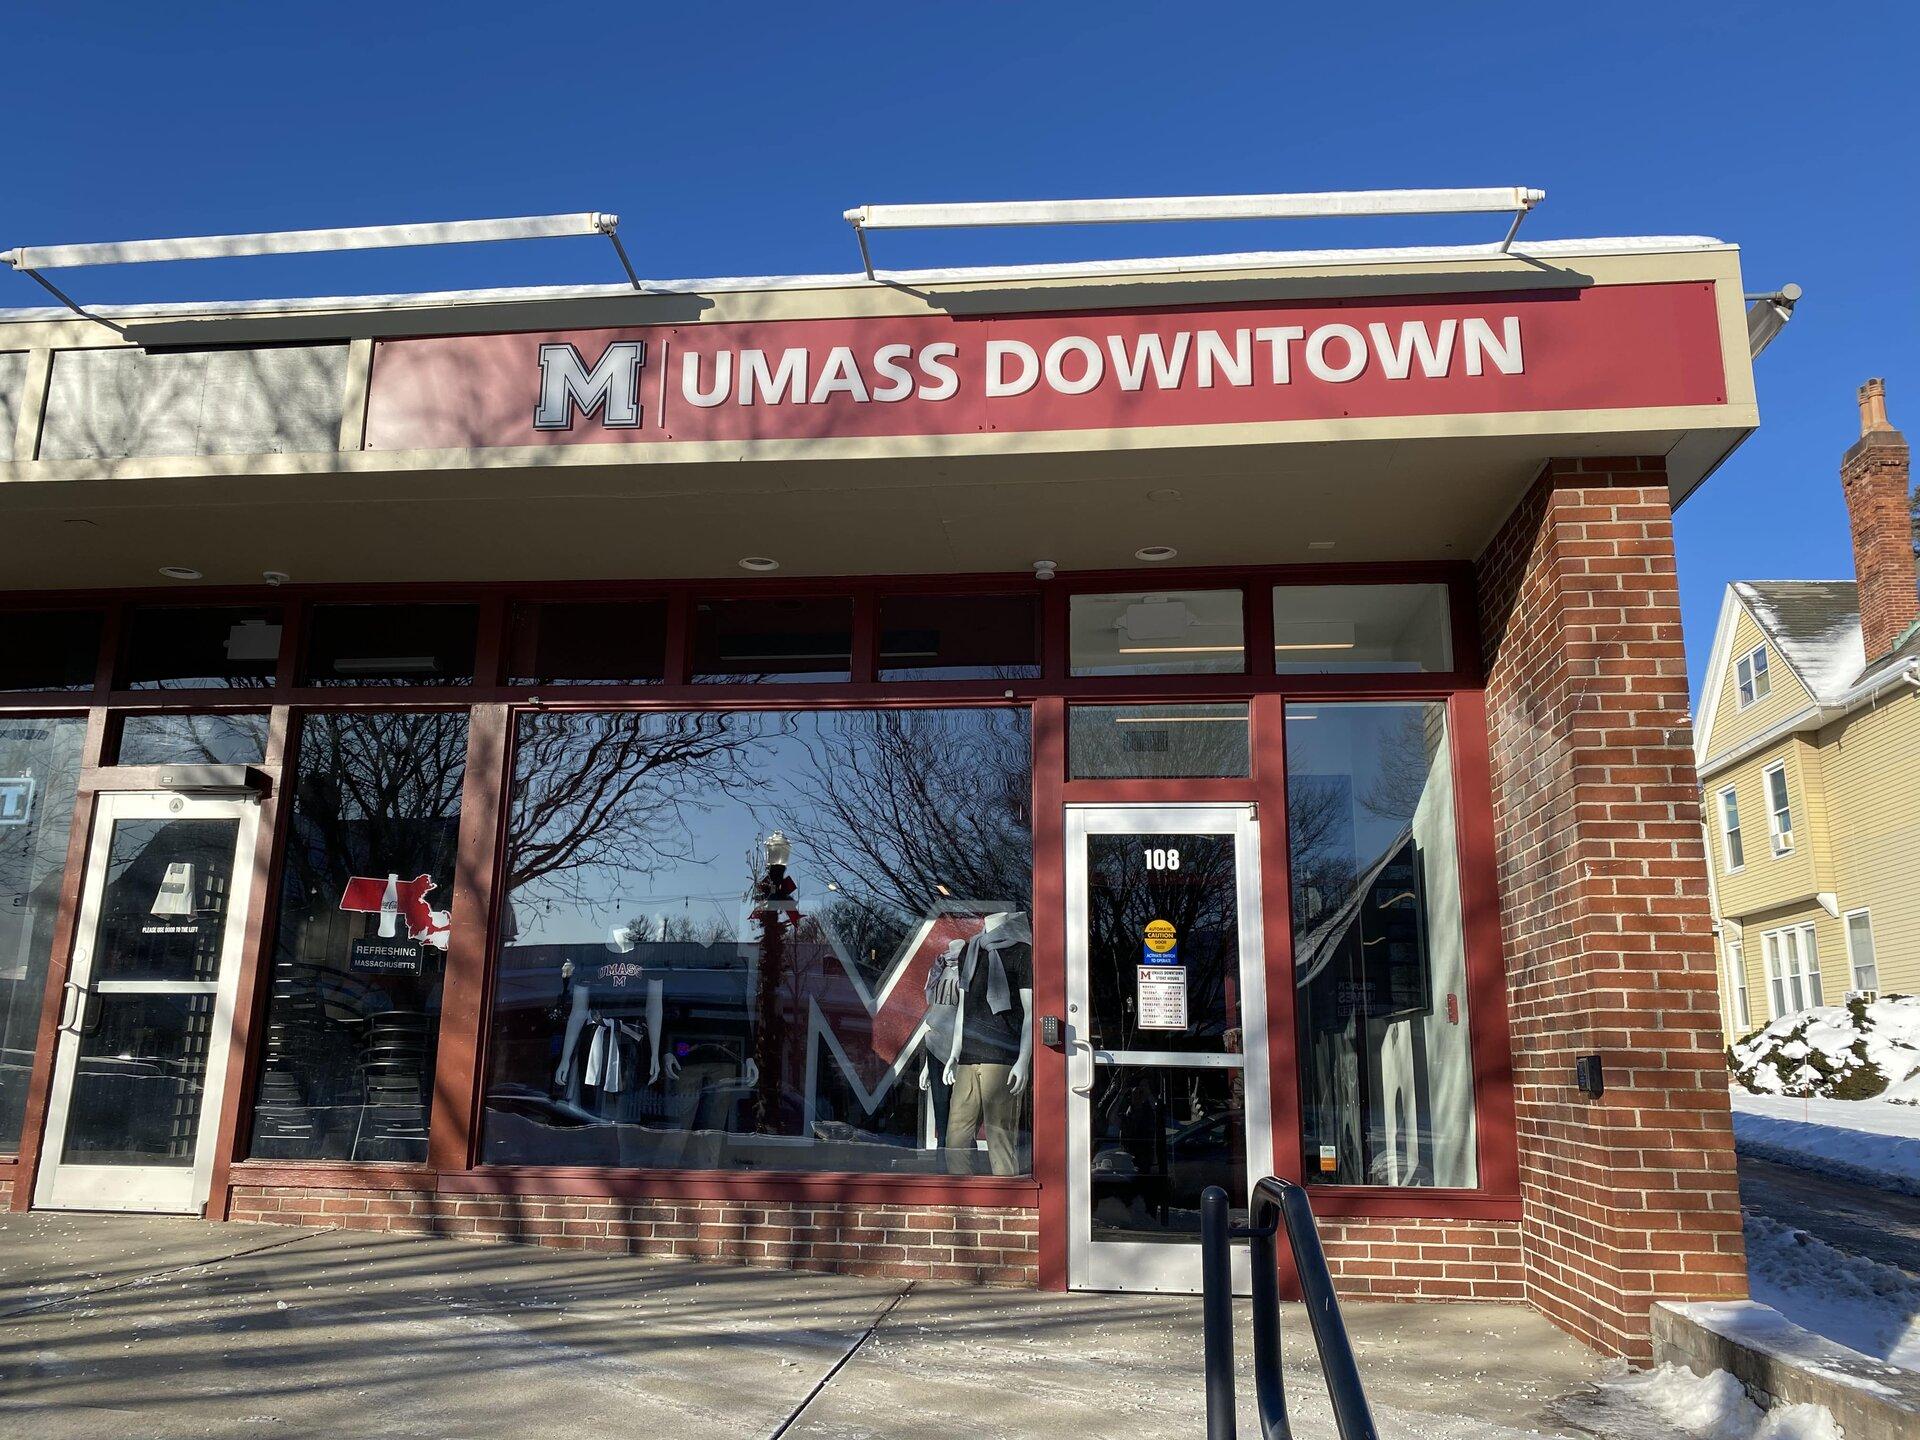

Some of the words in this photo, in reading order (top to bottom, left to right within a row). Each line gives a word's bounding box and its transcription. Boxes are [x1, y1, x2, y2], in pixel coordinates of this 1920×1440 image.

[533, 340, 645, 430] M
[682, 343, 959, 407] UMASS
[986, 316, 1523, 397] DOWNTOWN
[1144, 849, 1180, 870] 108
[356, 945, 416, 957] REFRESHING
[354, 960, 416, 970] MASSACHUSETTS
[598, 962, 642, 979] UMASS
[613, 975, 627, 987] M
[1140, 971, 1151, 980] M
